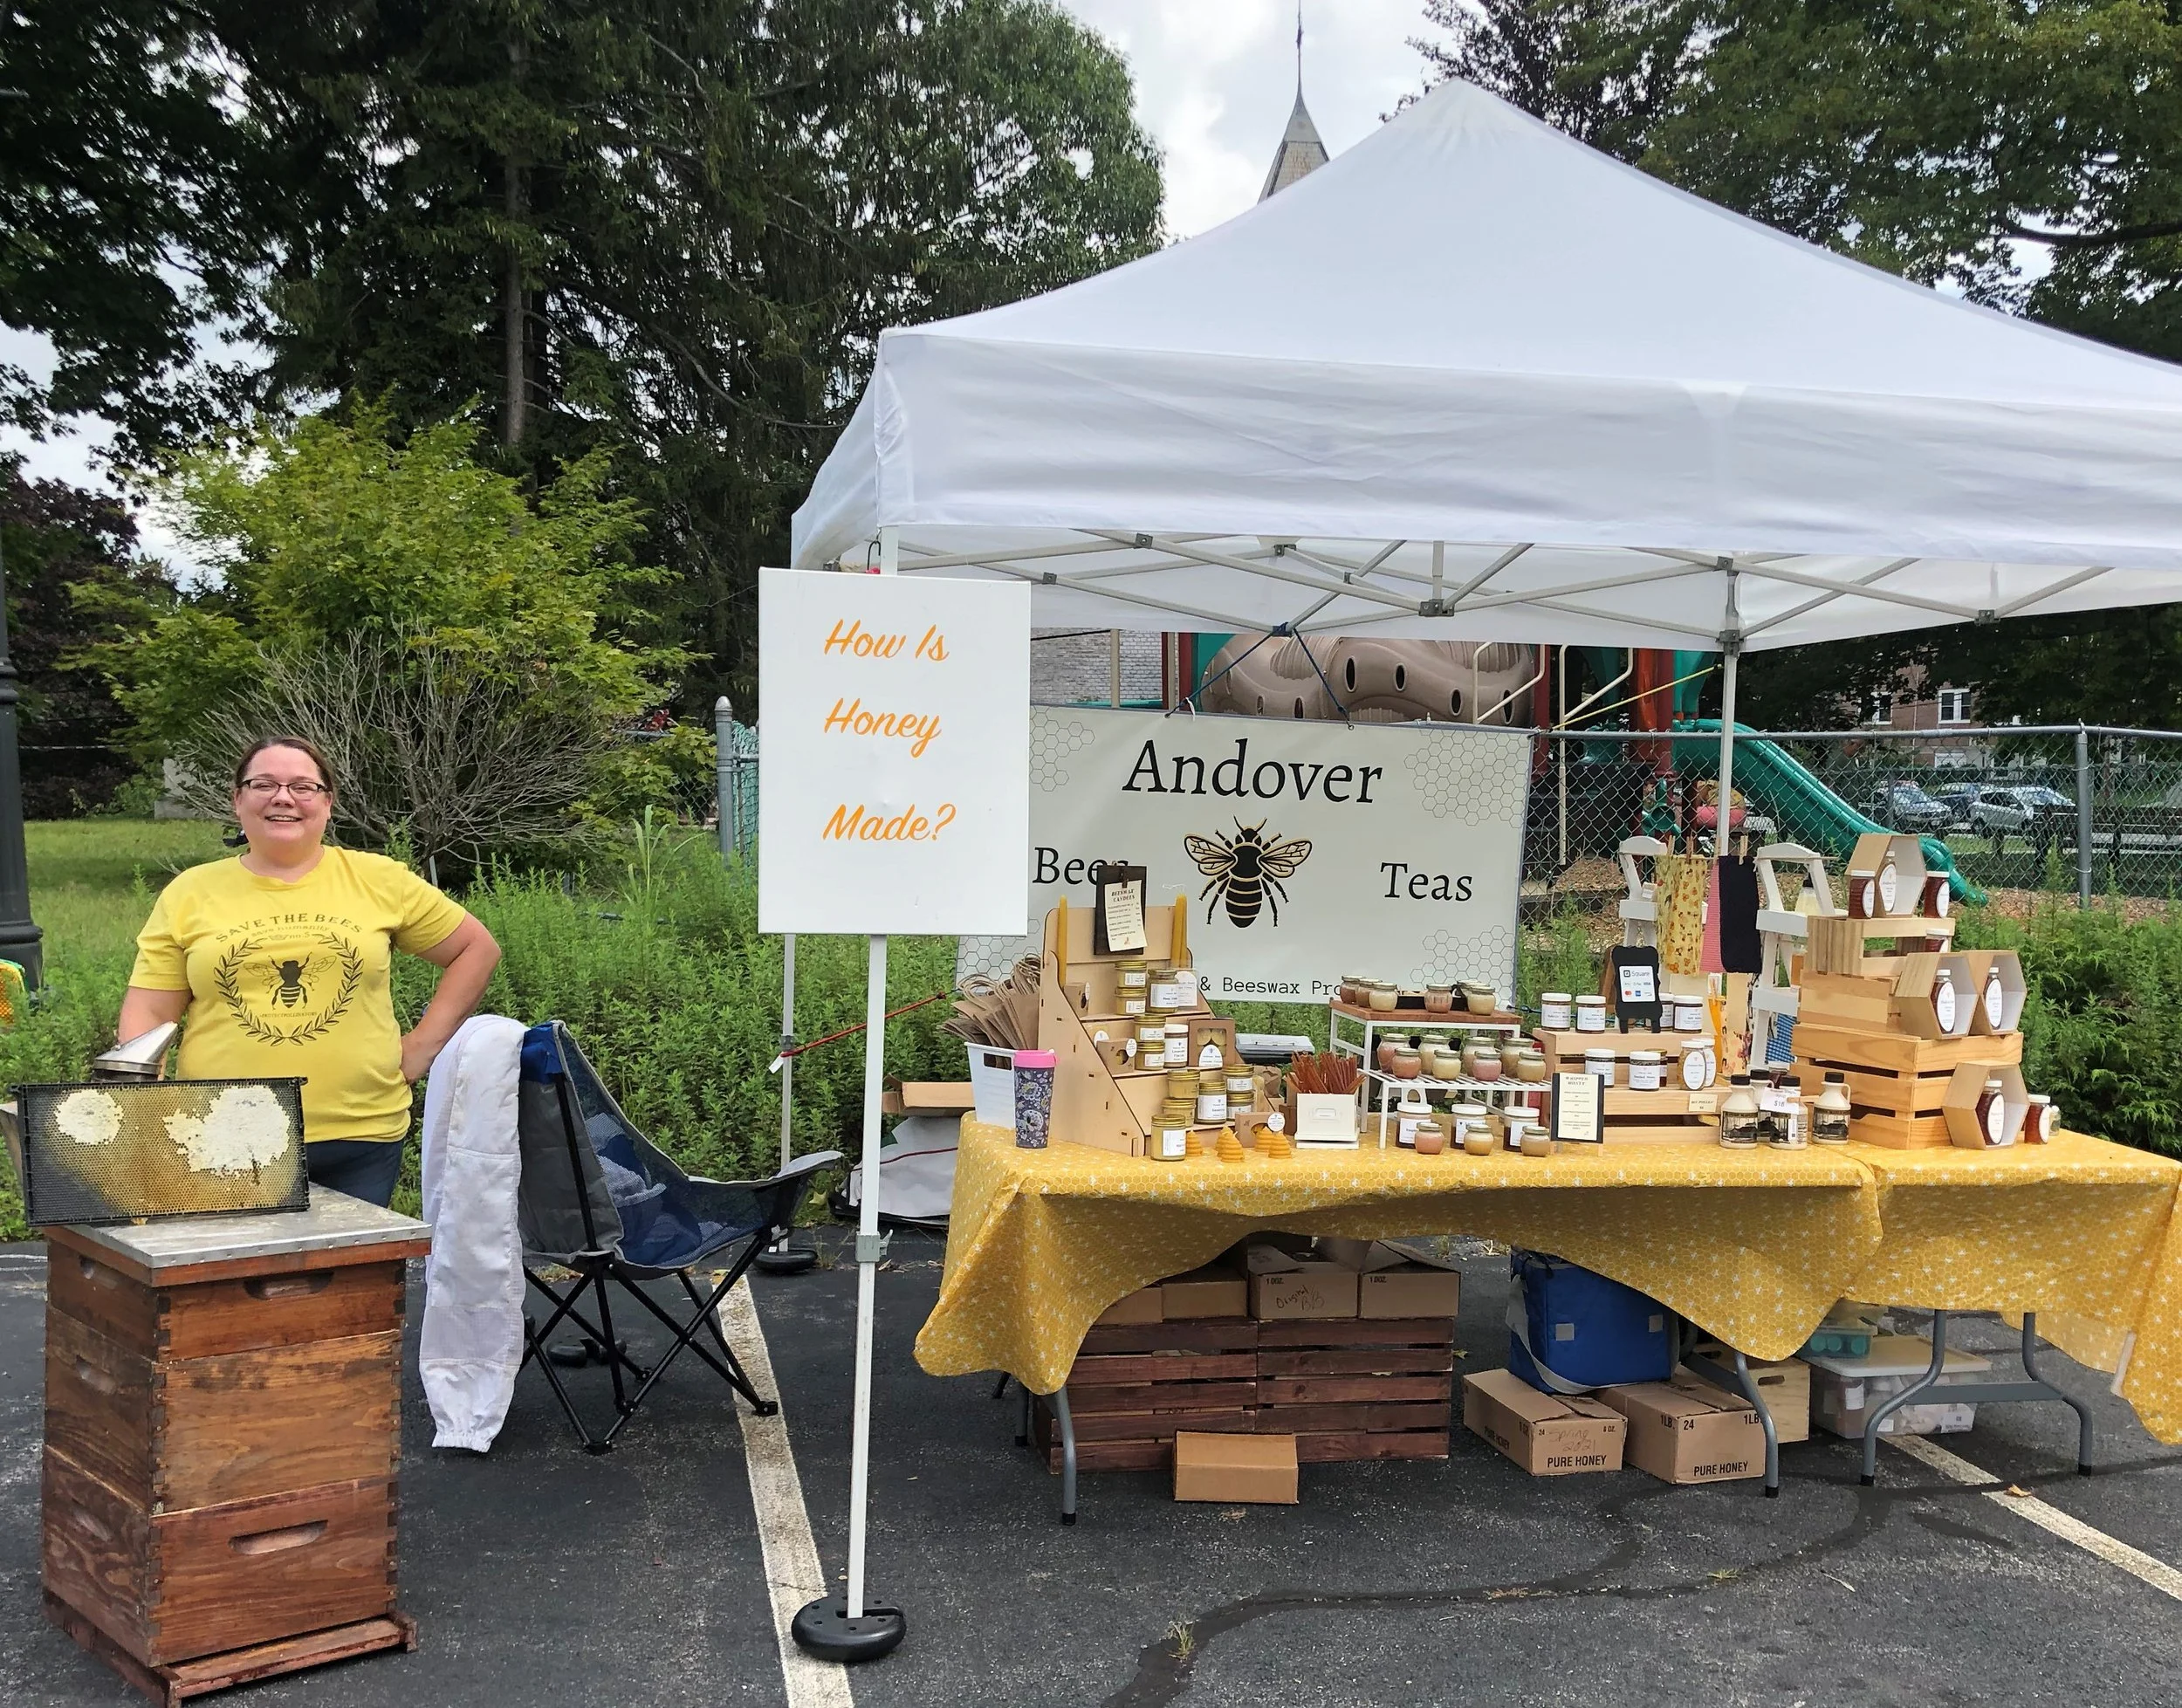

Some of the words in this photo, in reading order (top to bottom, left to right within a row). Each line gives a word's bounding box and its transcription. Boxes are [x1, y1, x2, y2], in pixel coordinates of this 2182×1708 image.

[823, 619, 906, 658] How
[915, 624, 950, 662] Is
[823, 697, 942, 758] Honey
[1122, 737, 1383, 804] Andover
[821, 803, 957, 840] Made?
[1033, 847, 1129, 885] Bee
[1380, 862, 1473, 902] Teas
[216, 919, 265, 943] SAVE
[270, 913, 308, 925] THE
[314, 914, 362, 933] BEES
[1200, 976, 1211, 991] &
[1223, 977, 1300, 994] Beeswax
[1683, 1419, 1694, 1430] 24
[1547, 1456, 1573, 1468] PURE
[1575, 1455, 1607, 1466] HONEY
[1693, 1464, 1717, 1477] PURE
[1719, 1461, 1748, 1474] HONEY
